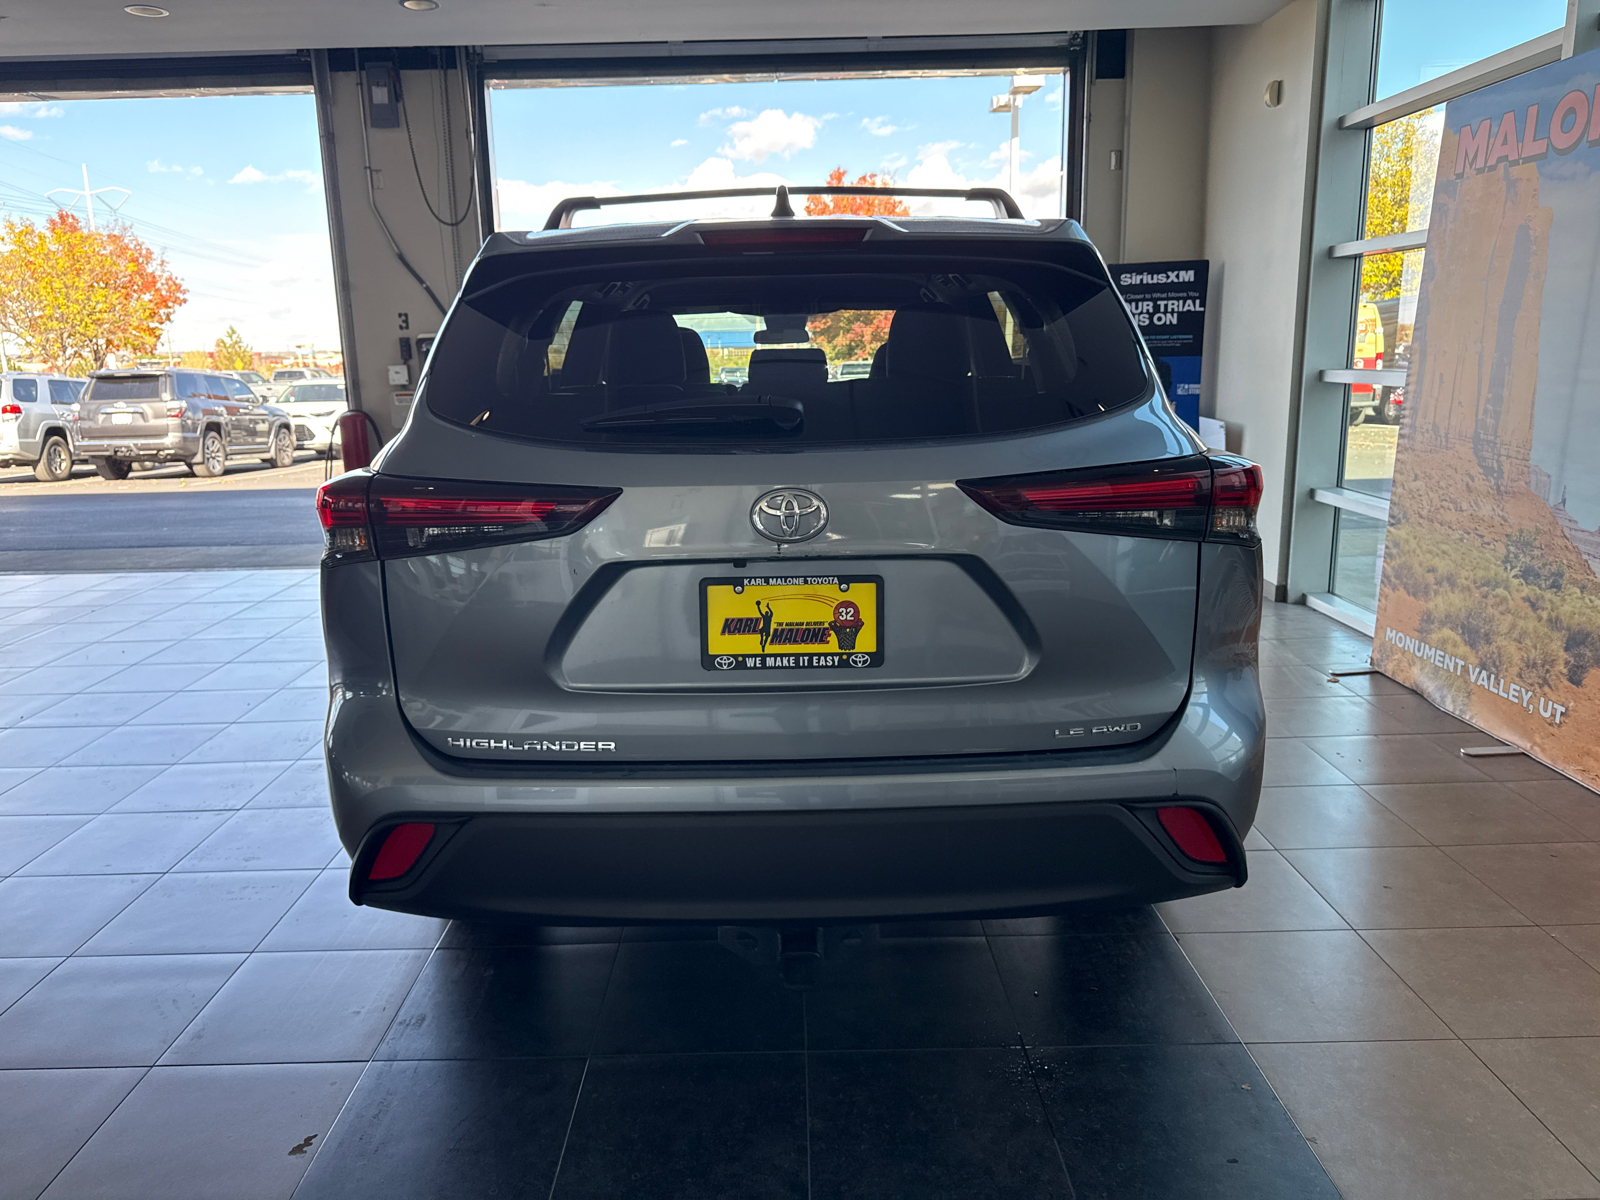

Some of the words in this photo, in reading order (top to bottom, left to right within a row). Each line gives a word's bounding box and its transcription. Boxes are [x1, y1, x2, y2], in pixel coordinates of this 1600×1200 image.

[1120, 270, 1194, 286] SiriusXM
[1126, 292, 1144, 300] Closer
[1157, 299, 1205, 313] TRIAL
[398, 313, 410, 330] 3
[1153, 313, 1178, 326] ON
[743, 578, 767, 586] KARL
[769, 577, 805, 586] MALONE
[806, 577, 839, 585] TOYOTA
[838, 607, 855, 620] 32
[720, 617, 762, 636] KARL
[769, 627, 832, 646] MALONE
[745, 657, 762, 668] WE
[766, 656, 796, 667] MAKE
[800, 656, 809, 667] IT
[812, 656, 840, 667] EASY
[1385, 626, 1465, 676] MONUMENT
[1468, 664, 1534, 714] VALLEY,
[1538, 697, 1566, 724] UT
[1054, 727, 1085, 738] LE
[1092, 722, 1142, 734] AWD
[447, 737, 617, 752] HIGHLANDER
